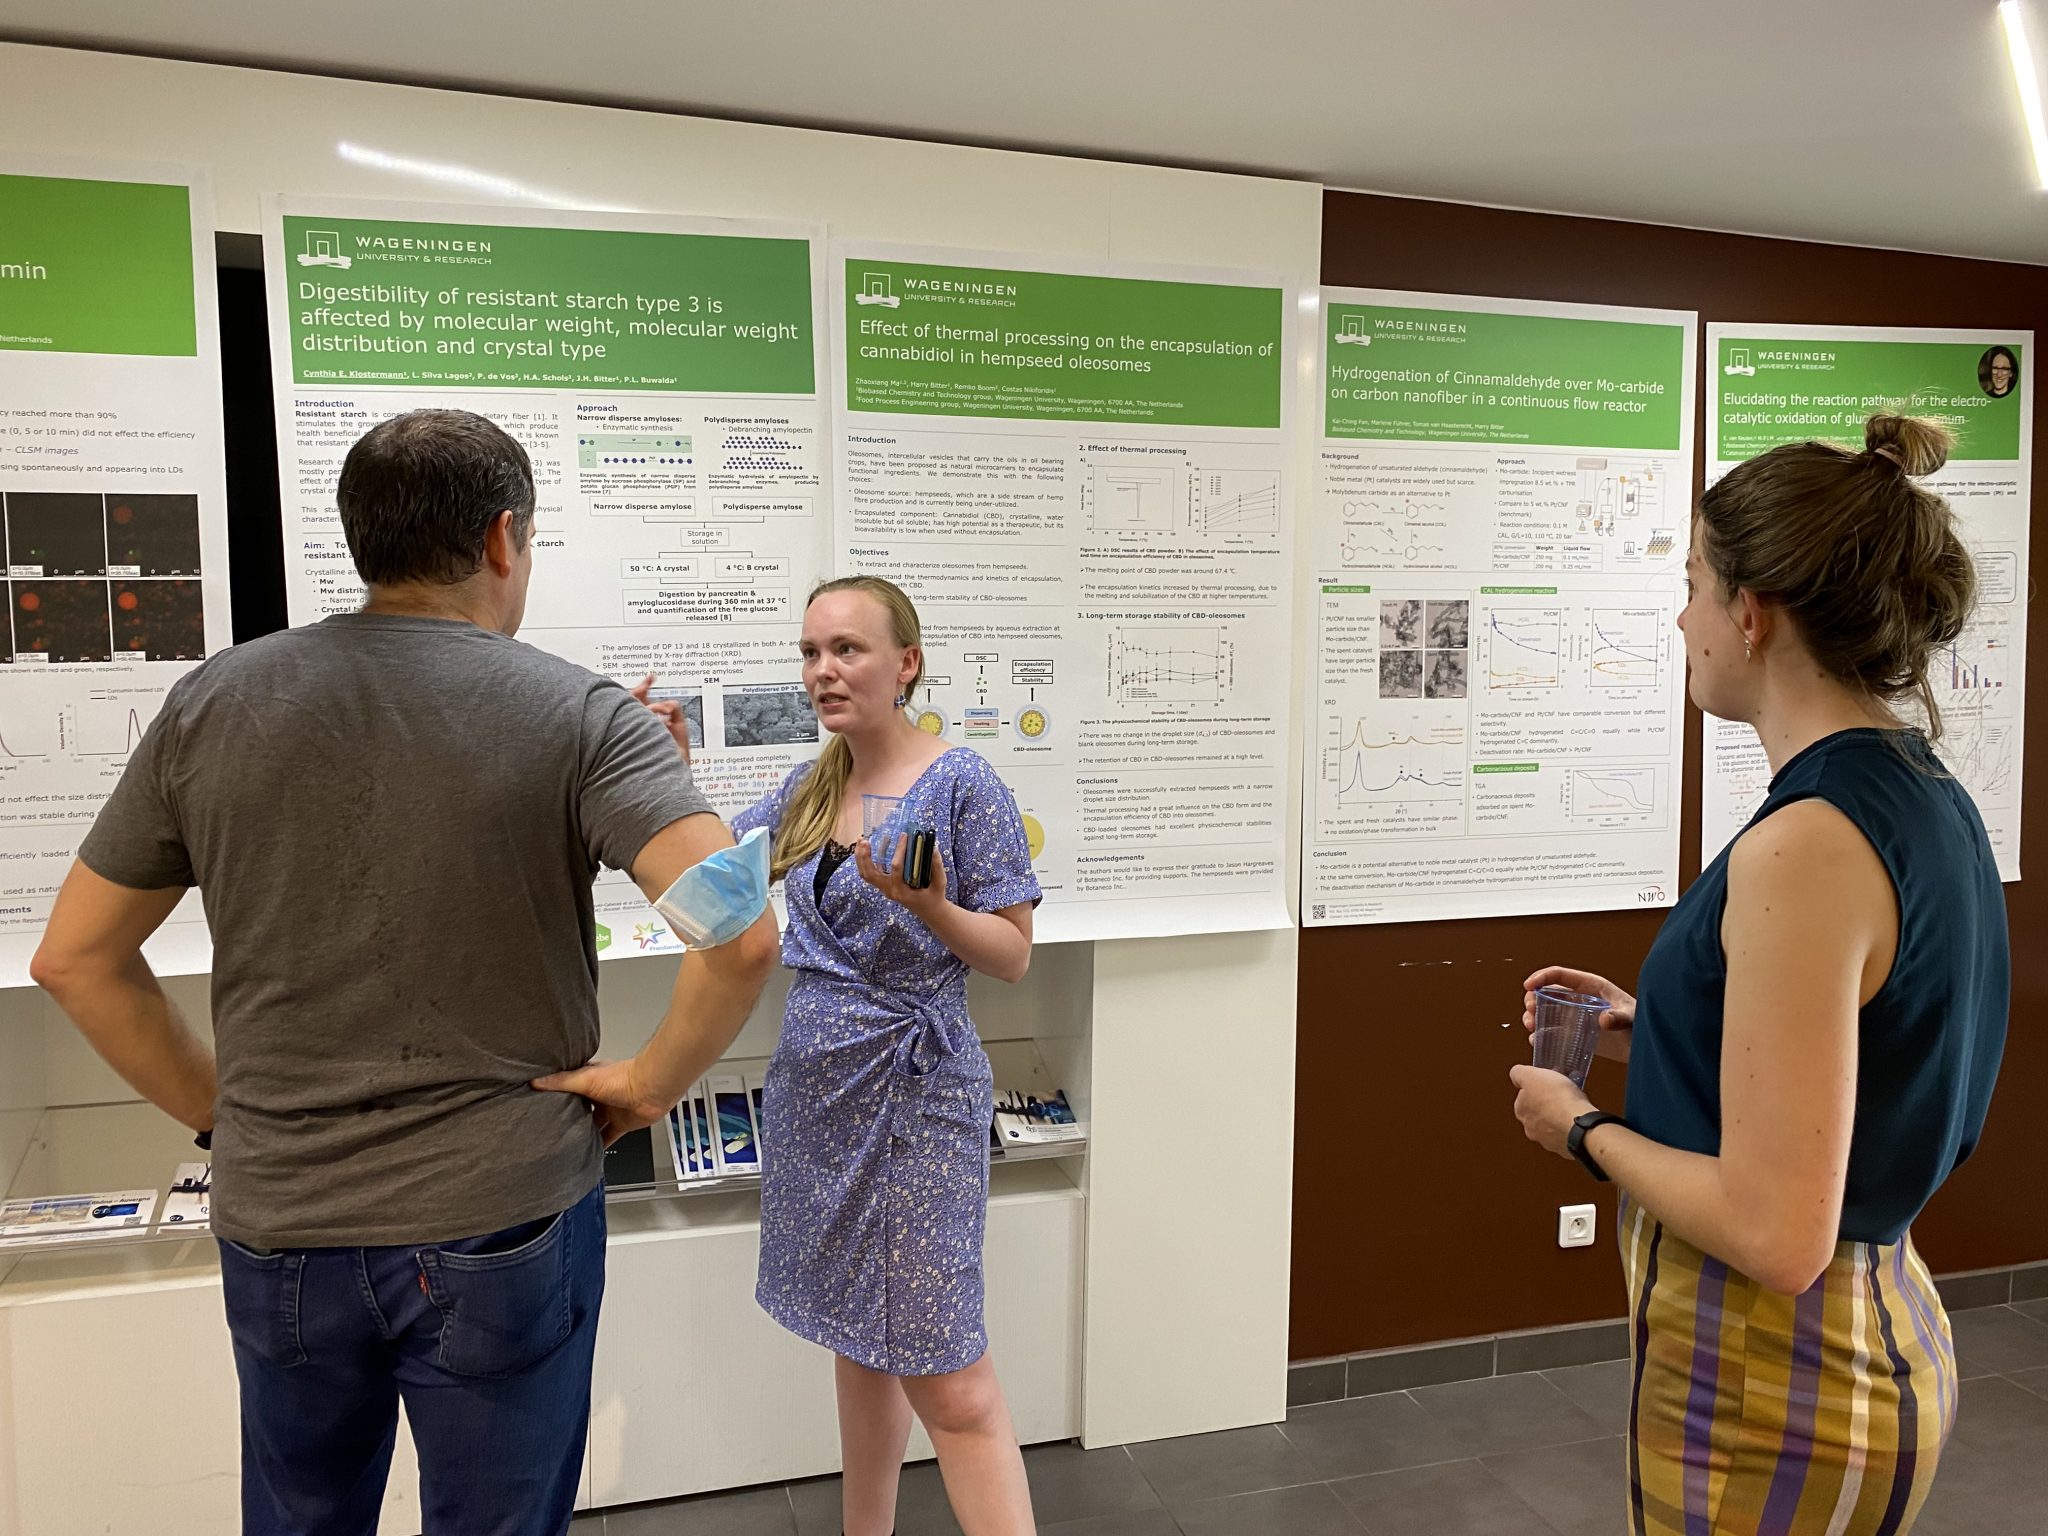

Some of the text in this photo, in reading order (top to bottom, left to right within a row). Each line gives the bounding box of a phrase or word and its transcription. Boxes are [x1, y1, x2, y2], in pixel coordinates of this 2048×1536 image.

[356, 236, 491, 253] WAGENINGEN
[356, 252, 491, 265] UNIVERSITY & RESEARCH
[904, 278, 1017, 296] WAGENINGEN
[299, 282, 723, 316] Digestibility of resistant starch type 3 is
[904, 294, 956, 303] UNIVERSITY
[968, 298, 1016, 308] RESEARCH
[301, 308, 798, 342] affected by molecular weight, molecular weight
[1374, 319, 1466, 333] WAGENINGEN
[860, 319, 1273, 358] Effect of thermal processing on the encapsulation of
[303, 334, 606, 362] distribution and crystal type
[860, 344, 1151, 373] cannabidiol in hempseed oleosomes
[1758, 351, 1835, 361] WAGENINGEN
[1332, 365, 1664, 394] Hydrogenation of Cinnamaldehyde over Mo-carbide
[295, 400, 354, 408] Introduction
[1331, 386, 1647, 413] on carbon nanofiber in a continuous flow reactor
[1724, 393, 1787, 408] Elucidating
[1791, 393, 1809, 405] the
[1813, 395, 1858, 406] reaction
[1911, 395, 1926, 406] for
[1930, 395, 1947, 407] the
[1951, 396, 1991, 407] electro-
[577, 404, 618, 413] Approach
[12, 409, 47, 417] reached
[74, 411, 95, 420] than
[97, 411, 118, 420] 90%
[295, 410, 336, 418] Resistant
[1724, 411, 1843, 424] catalytic oxidation of
[608, 415, 642, 423] disperse
[704, 416, 789, 425] Polydisperse amyloses
[602, 424, 673, 432] Enzymatic synthesis
[728, 426, 813, 435] Debranching amylopectin
[9, 427, 22, 437] (0,
[59, 428, 80, 438] min)
[82, 428, 96, 437] did
[98, 430, 113, 438] not
[115, 430, 139, 439] effect
[141, 430, 155, 439] the
[157, 431, 196, 441] efficiency
[848, 436, 896, 444] Introduction
[15, 446, 79, 457] CLSM images
[1149, 447, 1187, 455] processing
[1322, 453, 1359, 462] Background
[1497, 458, 1525, 466] Approach
[21, 464, 84, 473] spontaneously
[86, 465, 102, 473] and
[104, 466, 147, 475] appearing
[168, 466, 184, 474] LDs
[660, 503, 692, 511] amylose
[723, 503, 771, 511] Polydisperse
[688, 530, 714, 538] Storage
[335, 541, 346, 549] To
[304, 552, 346, 560] resistant
[849, 548, 889, 556] Objectives
[1153, 612, 1181, 620] stability
[1077, 854, 1144, 863] Acknowledgements
[1313, 850, 1347, 858] Conclusion
